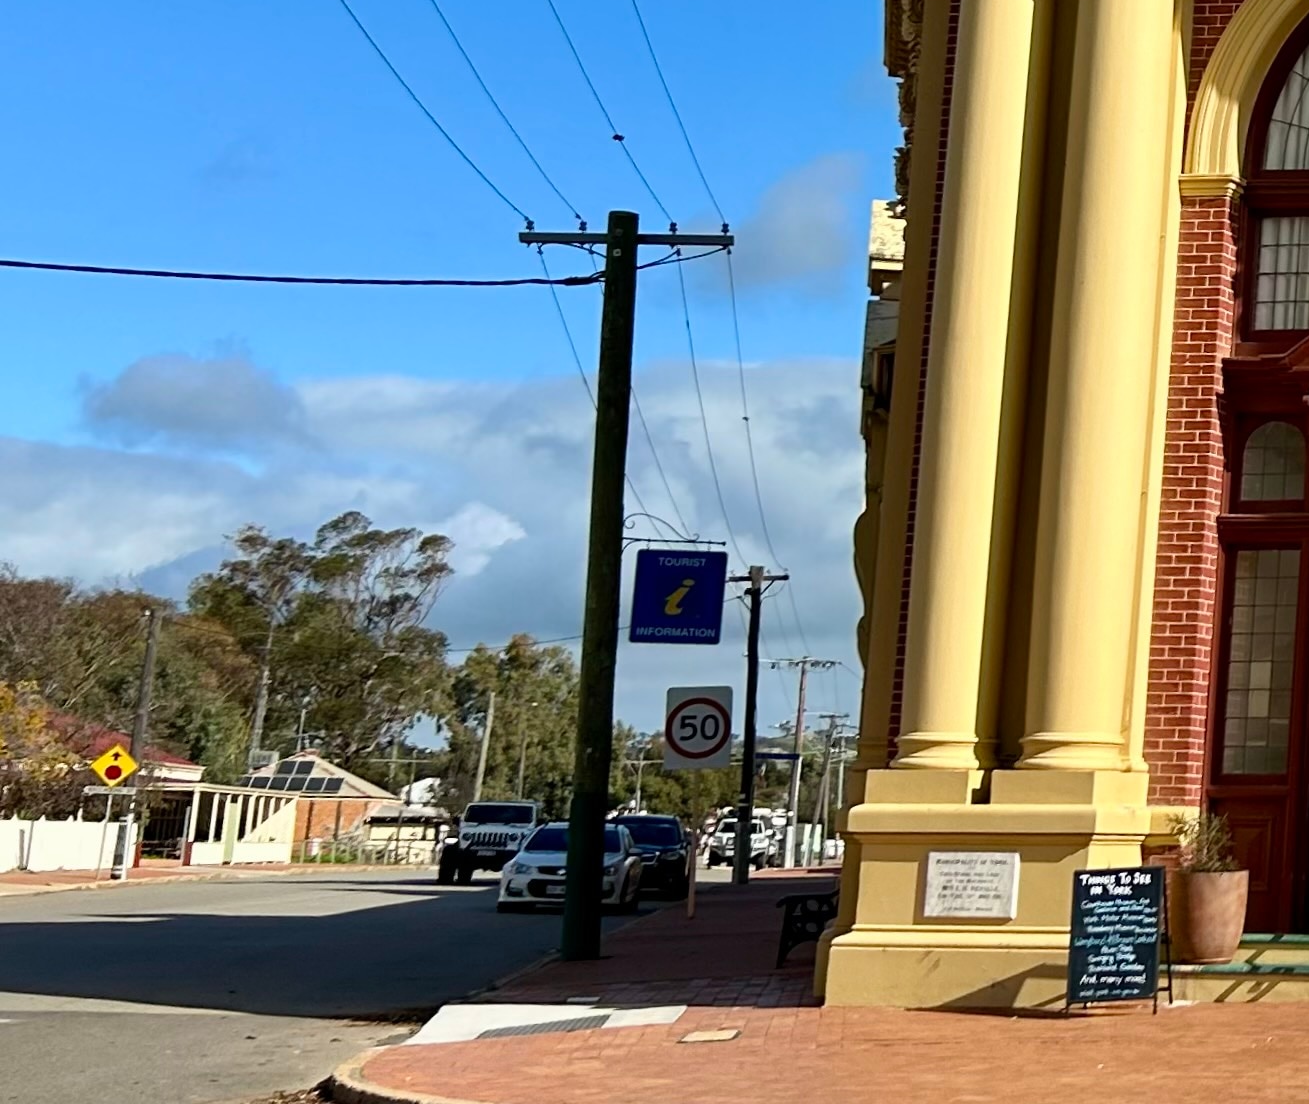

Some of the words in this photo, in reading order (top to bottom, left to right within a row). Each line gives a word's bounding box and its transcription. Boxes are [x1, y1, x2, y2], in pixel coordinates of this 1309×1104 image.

[658, 557, 706, 567] TOURIST
[636, 627, 716, 638] INFORMATION
[679, 714, 720, 741] 50
